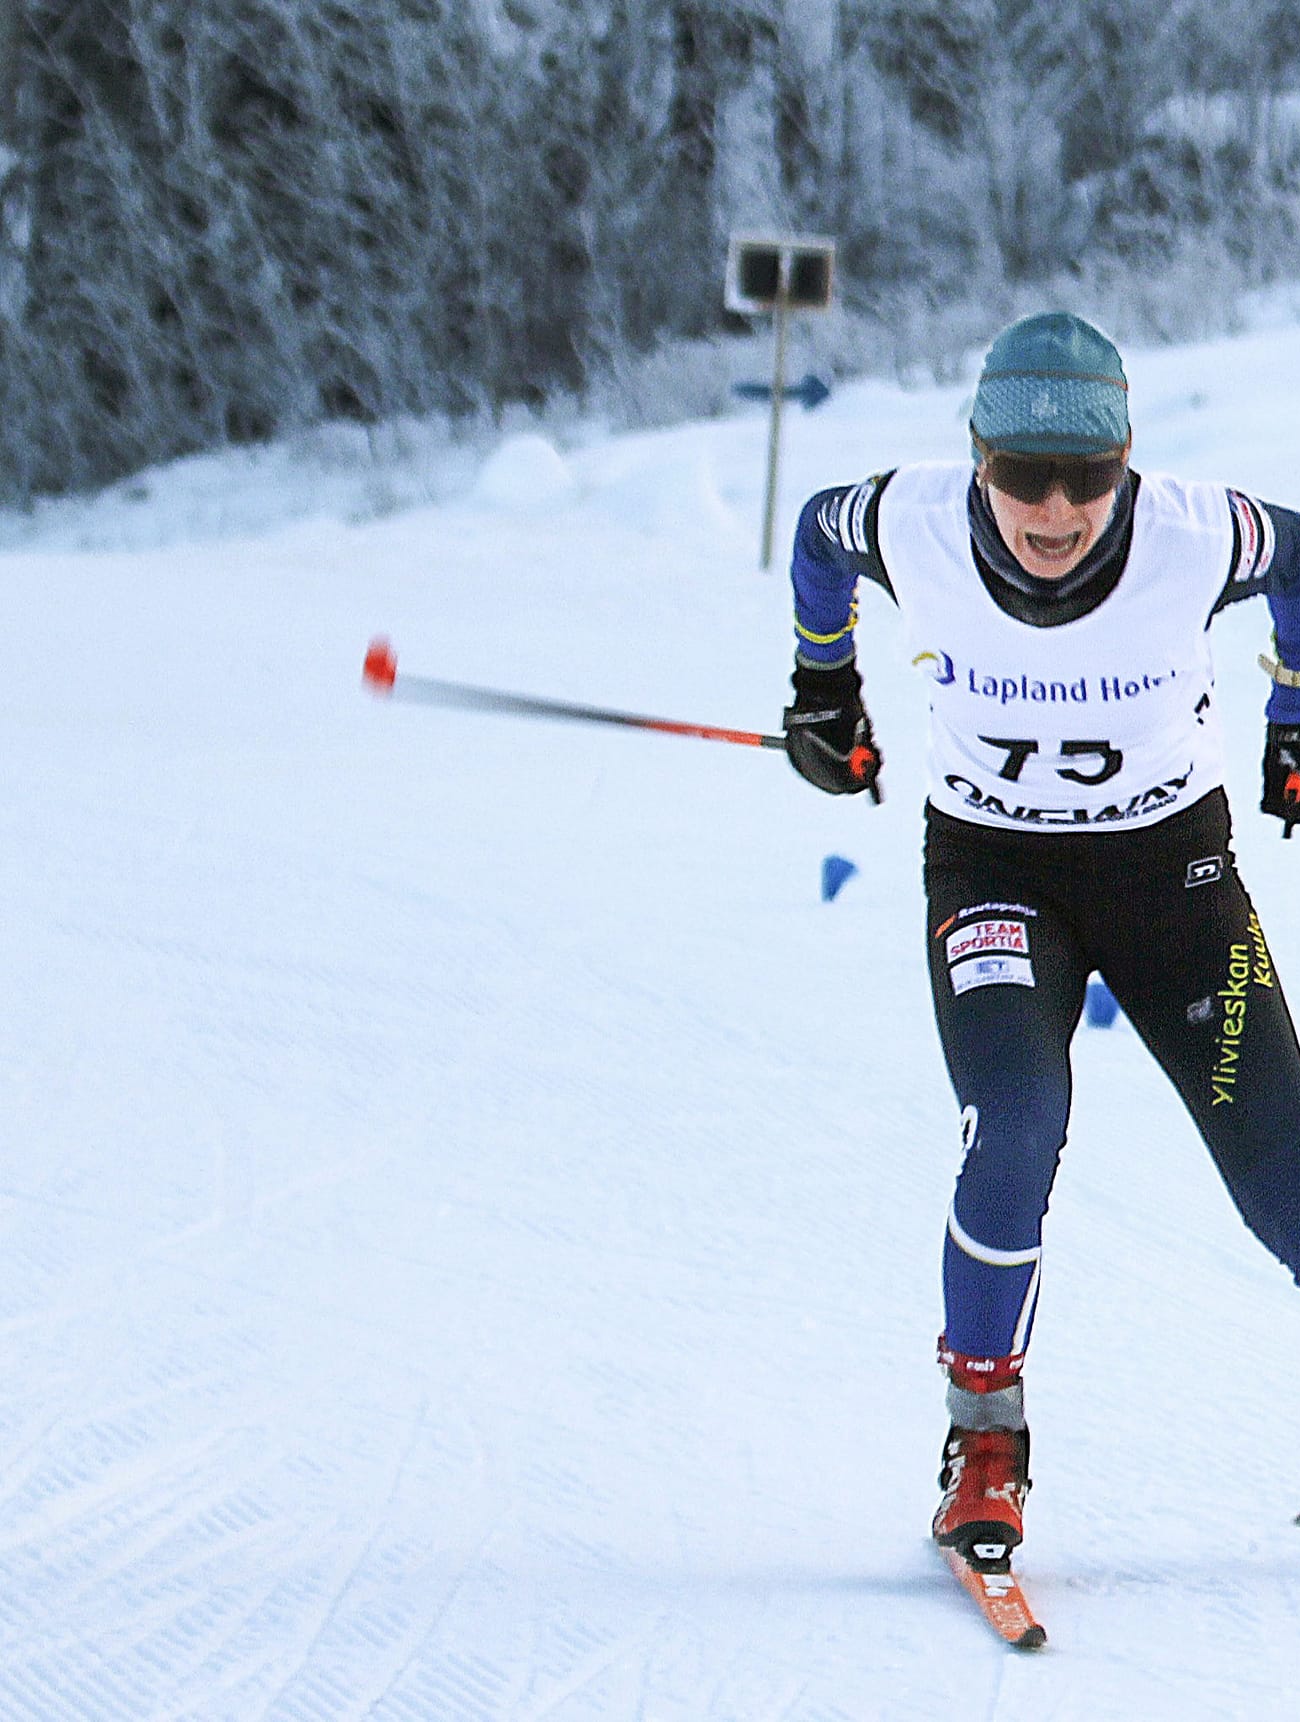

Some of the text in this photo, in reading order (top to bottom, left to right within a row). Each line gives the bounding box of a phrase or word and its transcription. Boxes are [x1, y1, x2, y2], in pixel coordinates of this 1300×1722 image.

[968, 668, 1087, 705] Lapland
[977, 732, 1124, 786] 75
[975, 922, 1023, 937] TEAM
[950, 935, 1024, 957] SPORTIA
